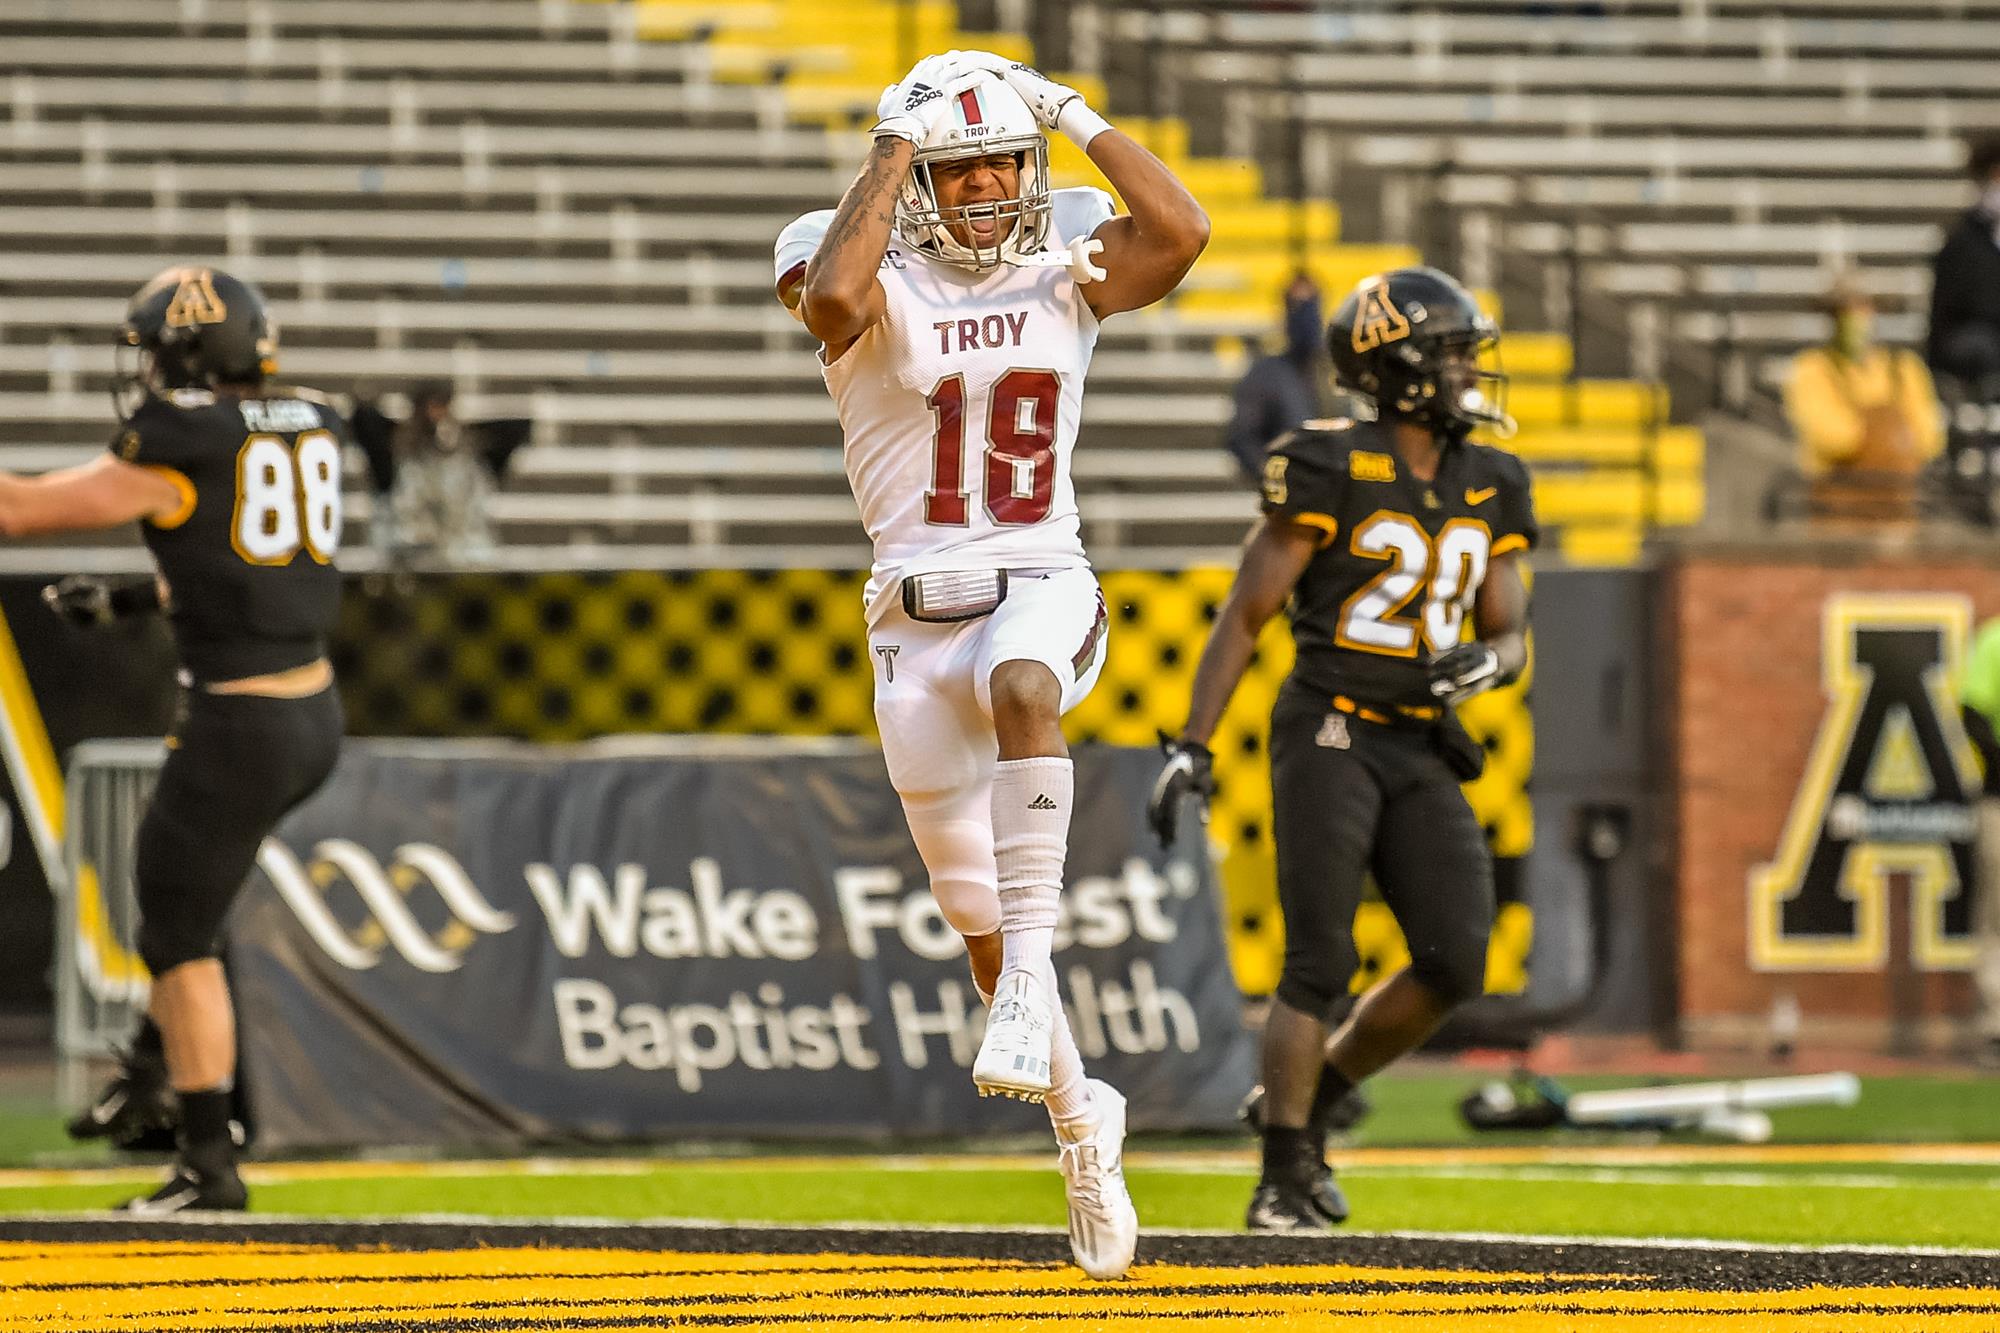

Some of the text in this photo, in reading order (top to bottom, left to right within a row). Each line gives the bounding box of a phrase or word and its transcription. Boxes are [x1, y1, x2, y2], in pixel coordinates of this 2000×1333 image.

[904, 89, 944, 111] adidas
[964, 126, 990, 138] TROY
[932, 311, 1029, 355] TROY
[230, 429, 342, 566] 88
[923, 366, 1063, 528] 18
[1334, 509, 1492, 659] 20
[875, 645, 900, 683] T
[1747, 593, 1985, 973] A
[525, 857, 1178, 961] Wake Fost
[553, 958, 1200, 1093] Baptist Hlth
